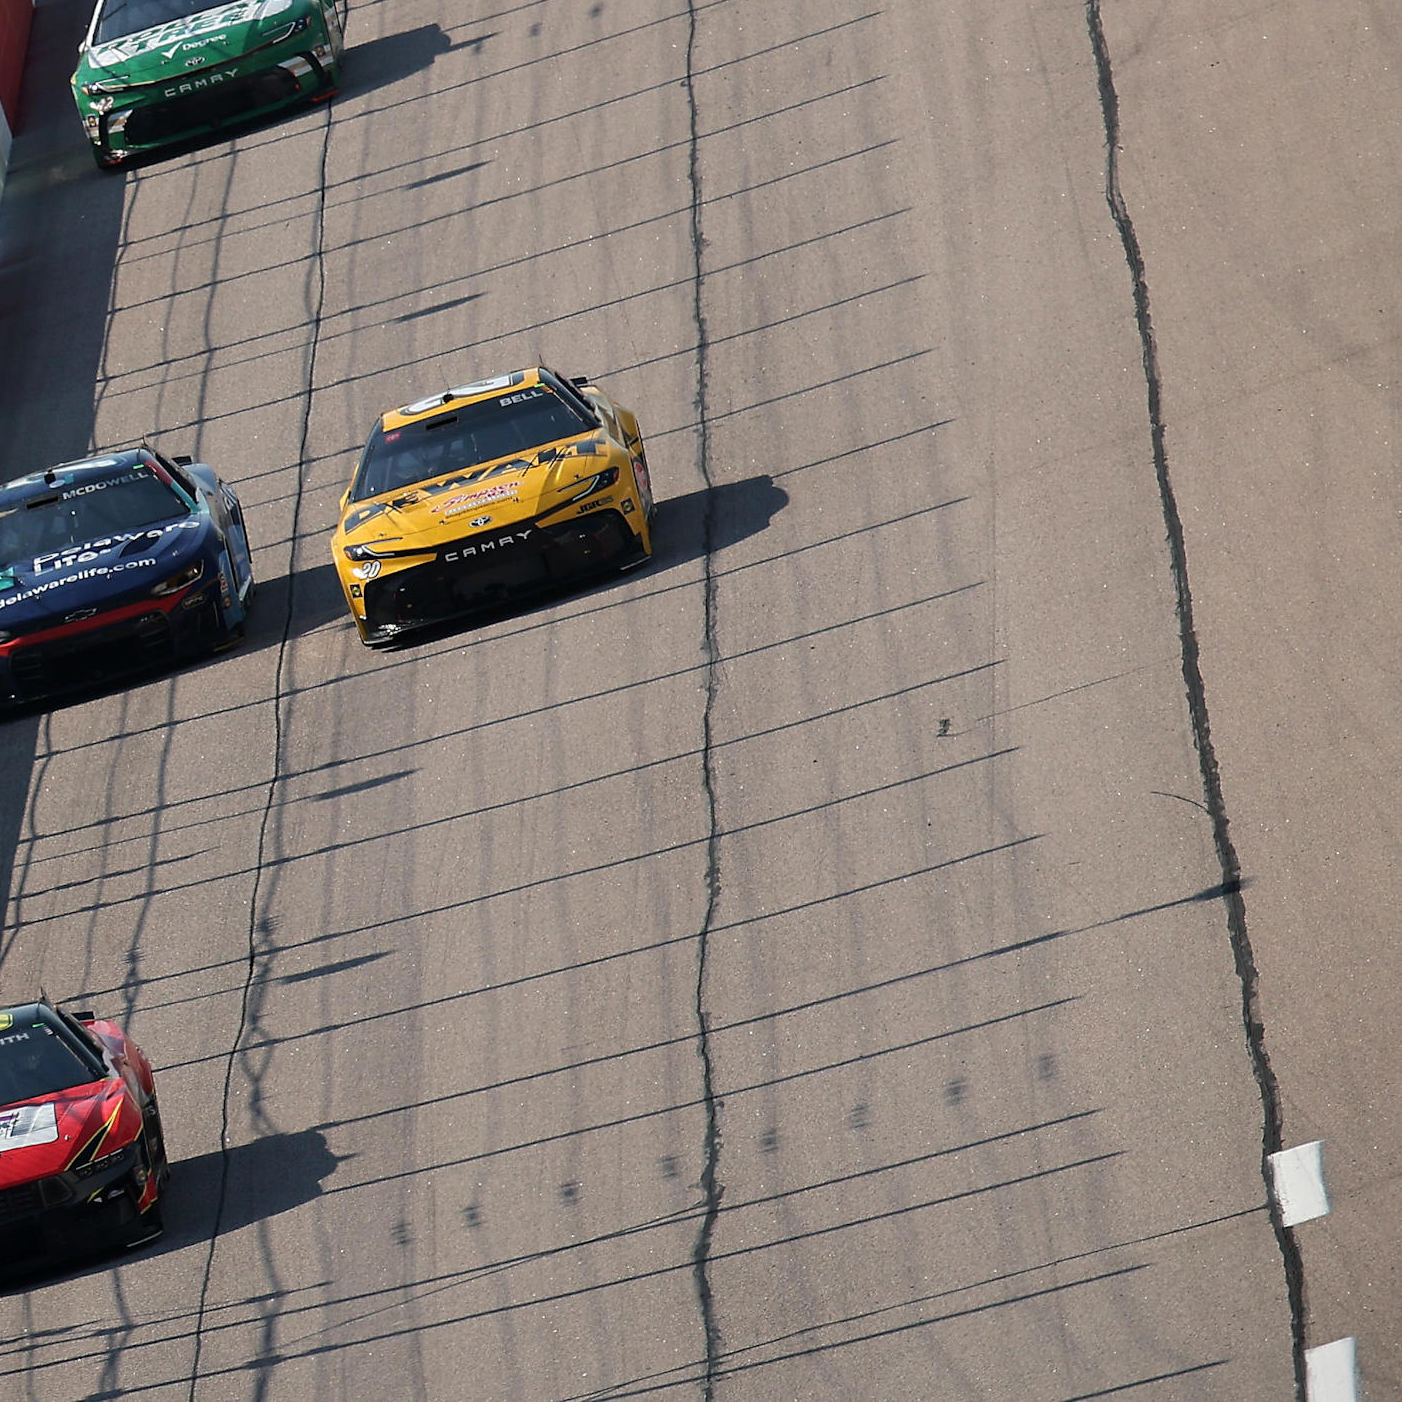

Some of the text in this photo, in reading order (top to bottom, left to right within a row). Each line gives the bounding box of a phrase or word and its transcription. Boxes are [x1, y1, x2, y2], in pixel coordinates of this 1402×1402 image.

[182, 33, 228, 52] Degree
[164, 68, 239, 98] CAMRY
[499, 390, 543, 407] BELL
[62, 471, 148, 500] MCDOWELL
[33, 521, 200, 568] Delaware
[445, 529, 532, 562] CAMRY
[360, 560, 381, 579] 20
